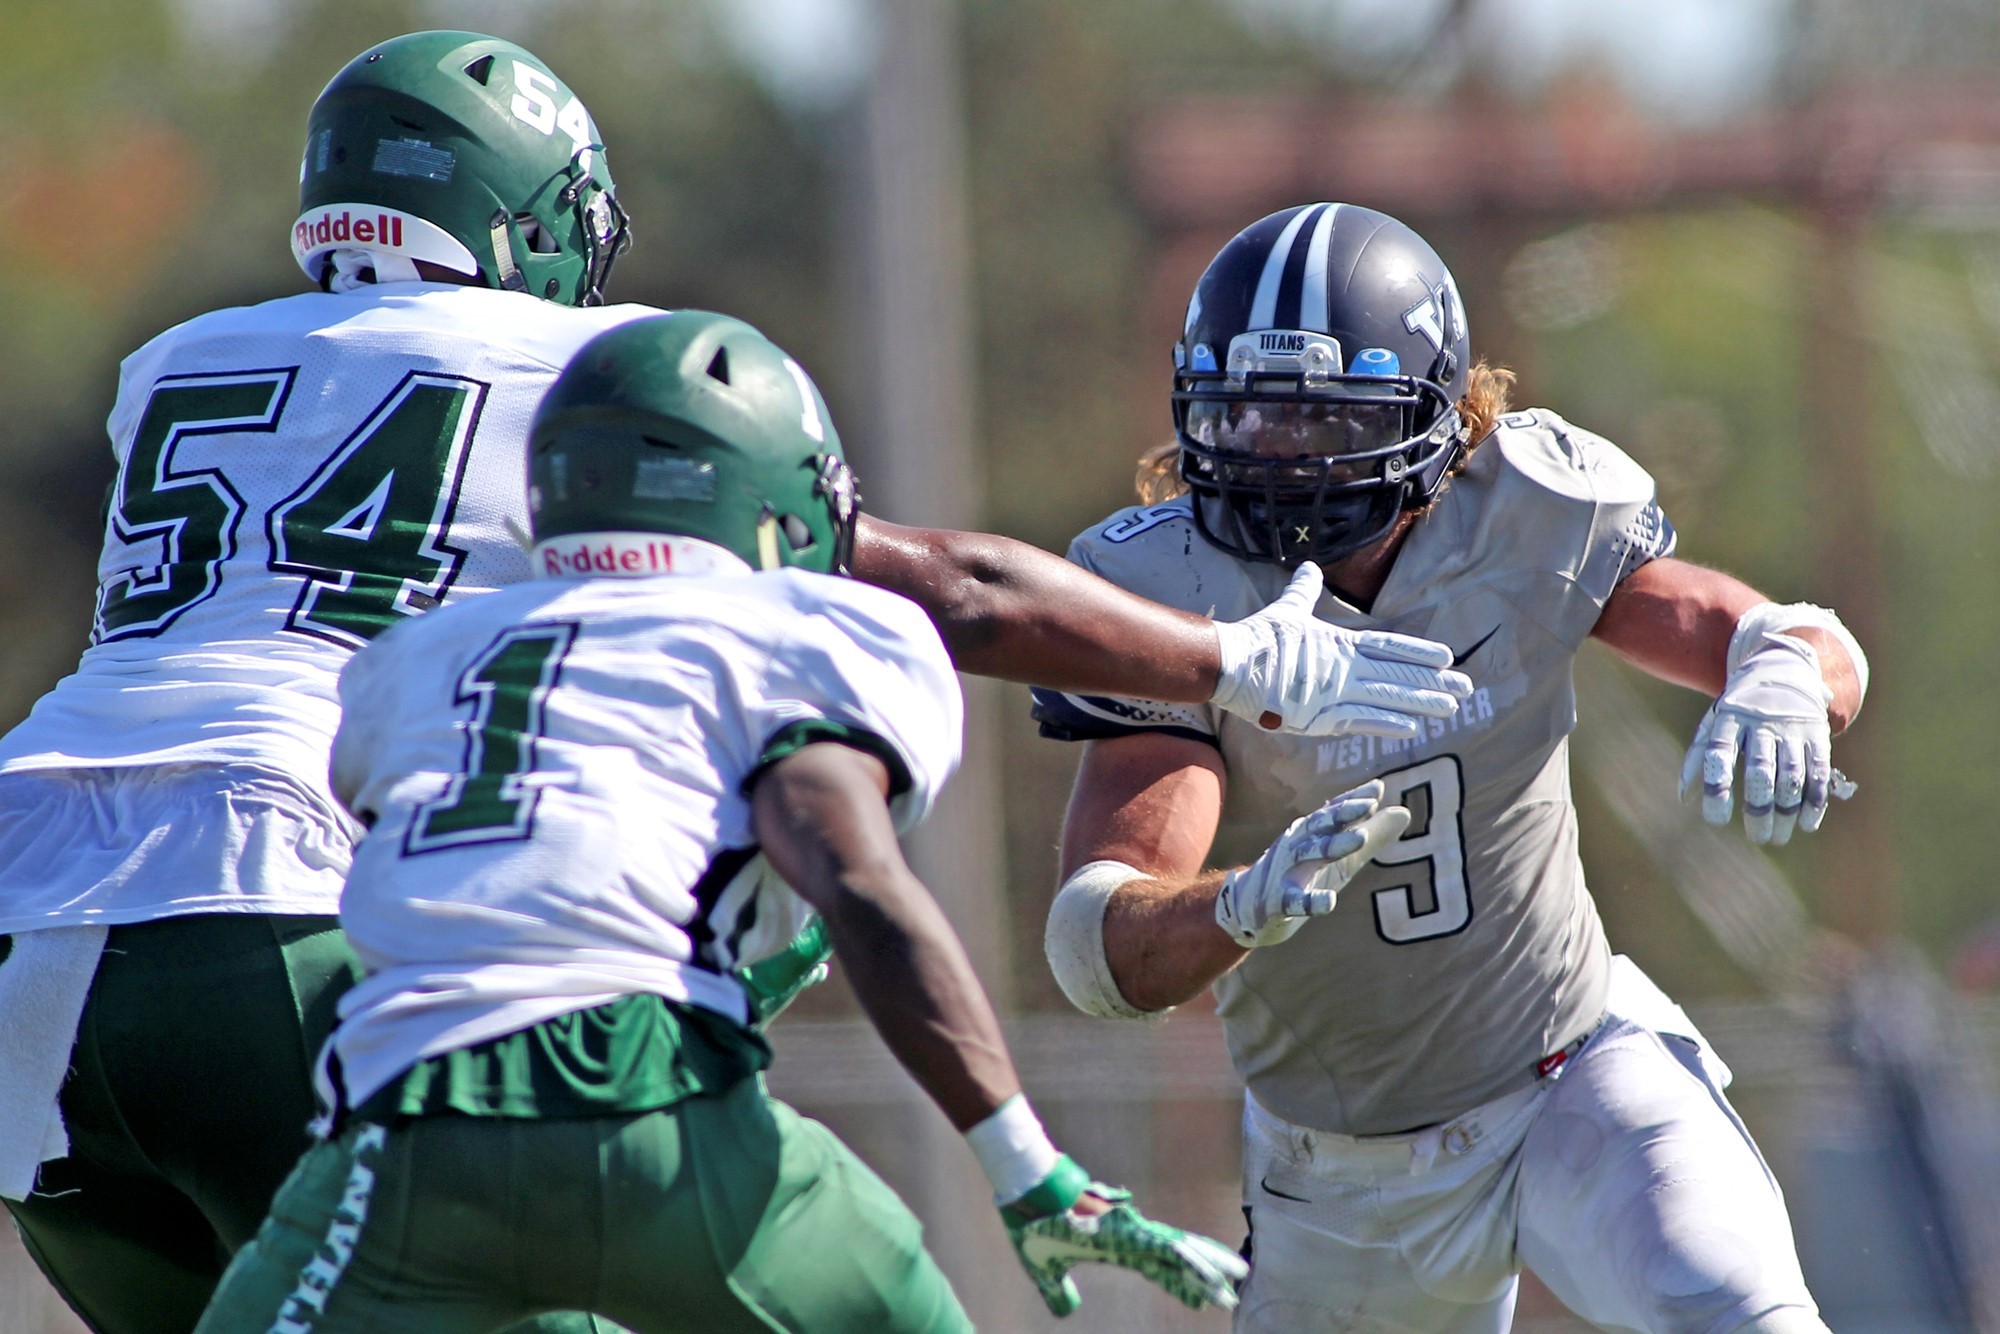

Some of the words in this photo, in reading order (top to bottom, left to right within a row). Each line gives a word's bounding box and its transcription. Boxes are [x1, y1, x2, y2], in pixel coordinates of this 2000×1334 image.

[511, 60, 592, 173] 54
[296, 211, 402, 255] Riddell
[1260, 334, 1305, 351] TITANS
[92, 366, 490, 650] 54
[544, 541, 673, 576] Riddell
[401, 622, 580, 858] 1
[1371, 752, 1474, 946] 9
